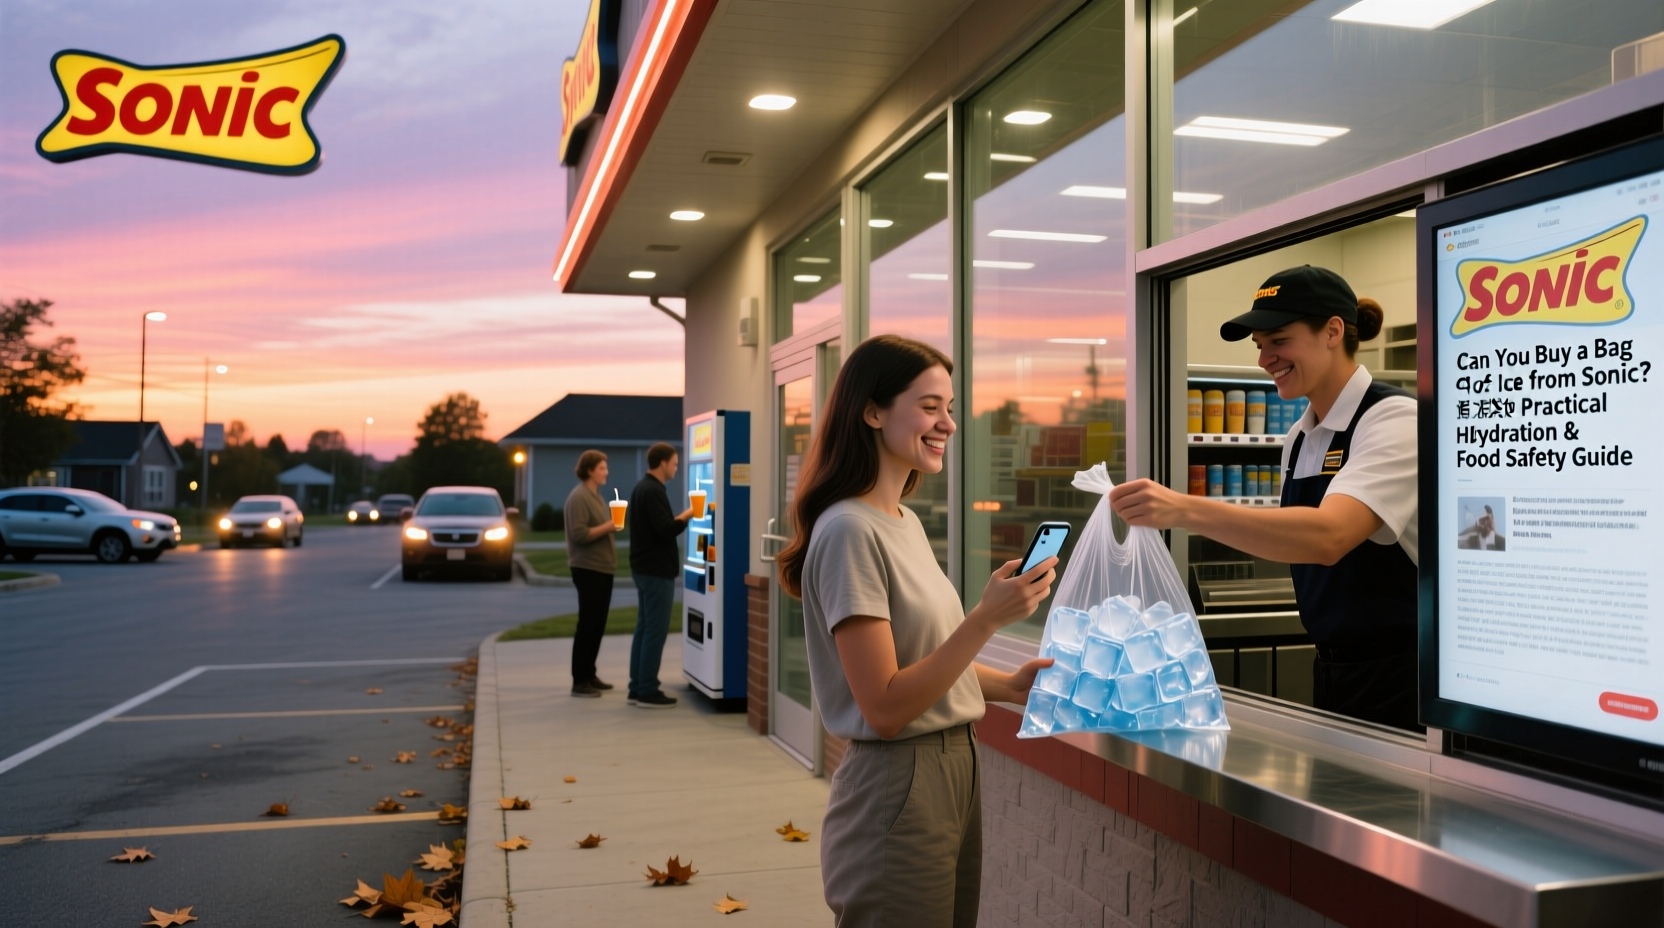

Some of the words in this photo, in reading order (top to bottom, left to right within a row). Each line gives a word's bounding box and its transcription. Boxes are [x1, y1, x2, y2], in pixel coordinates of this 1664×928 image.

[1457, 352, 1489, 370] Can
[1495, 348, 1529, 367] You
[1536, 345, 1571, 367] Buy
[1577, 345, 1588, 360] a
[1595, 338, 1633, 361] Bag
[1499, 374, 1523, 392] Ice
[1529, 370, 1575, 389] from
[1582, 361, 1651, 386] Sonic?
[1522, 391, 1606, 416] Practical
[1564, 421, 1579, 440] &
[1458, 448, 1500, 467] Food
[1506, 447, 1566, 472] Safety
[1572, 445, 1632, 467] Guide
